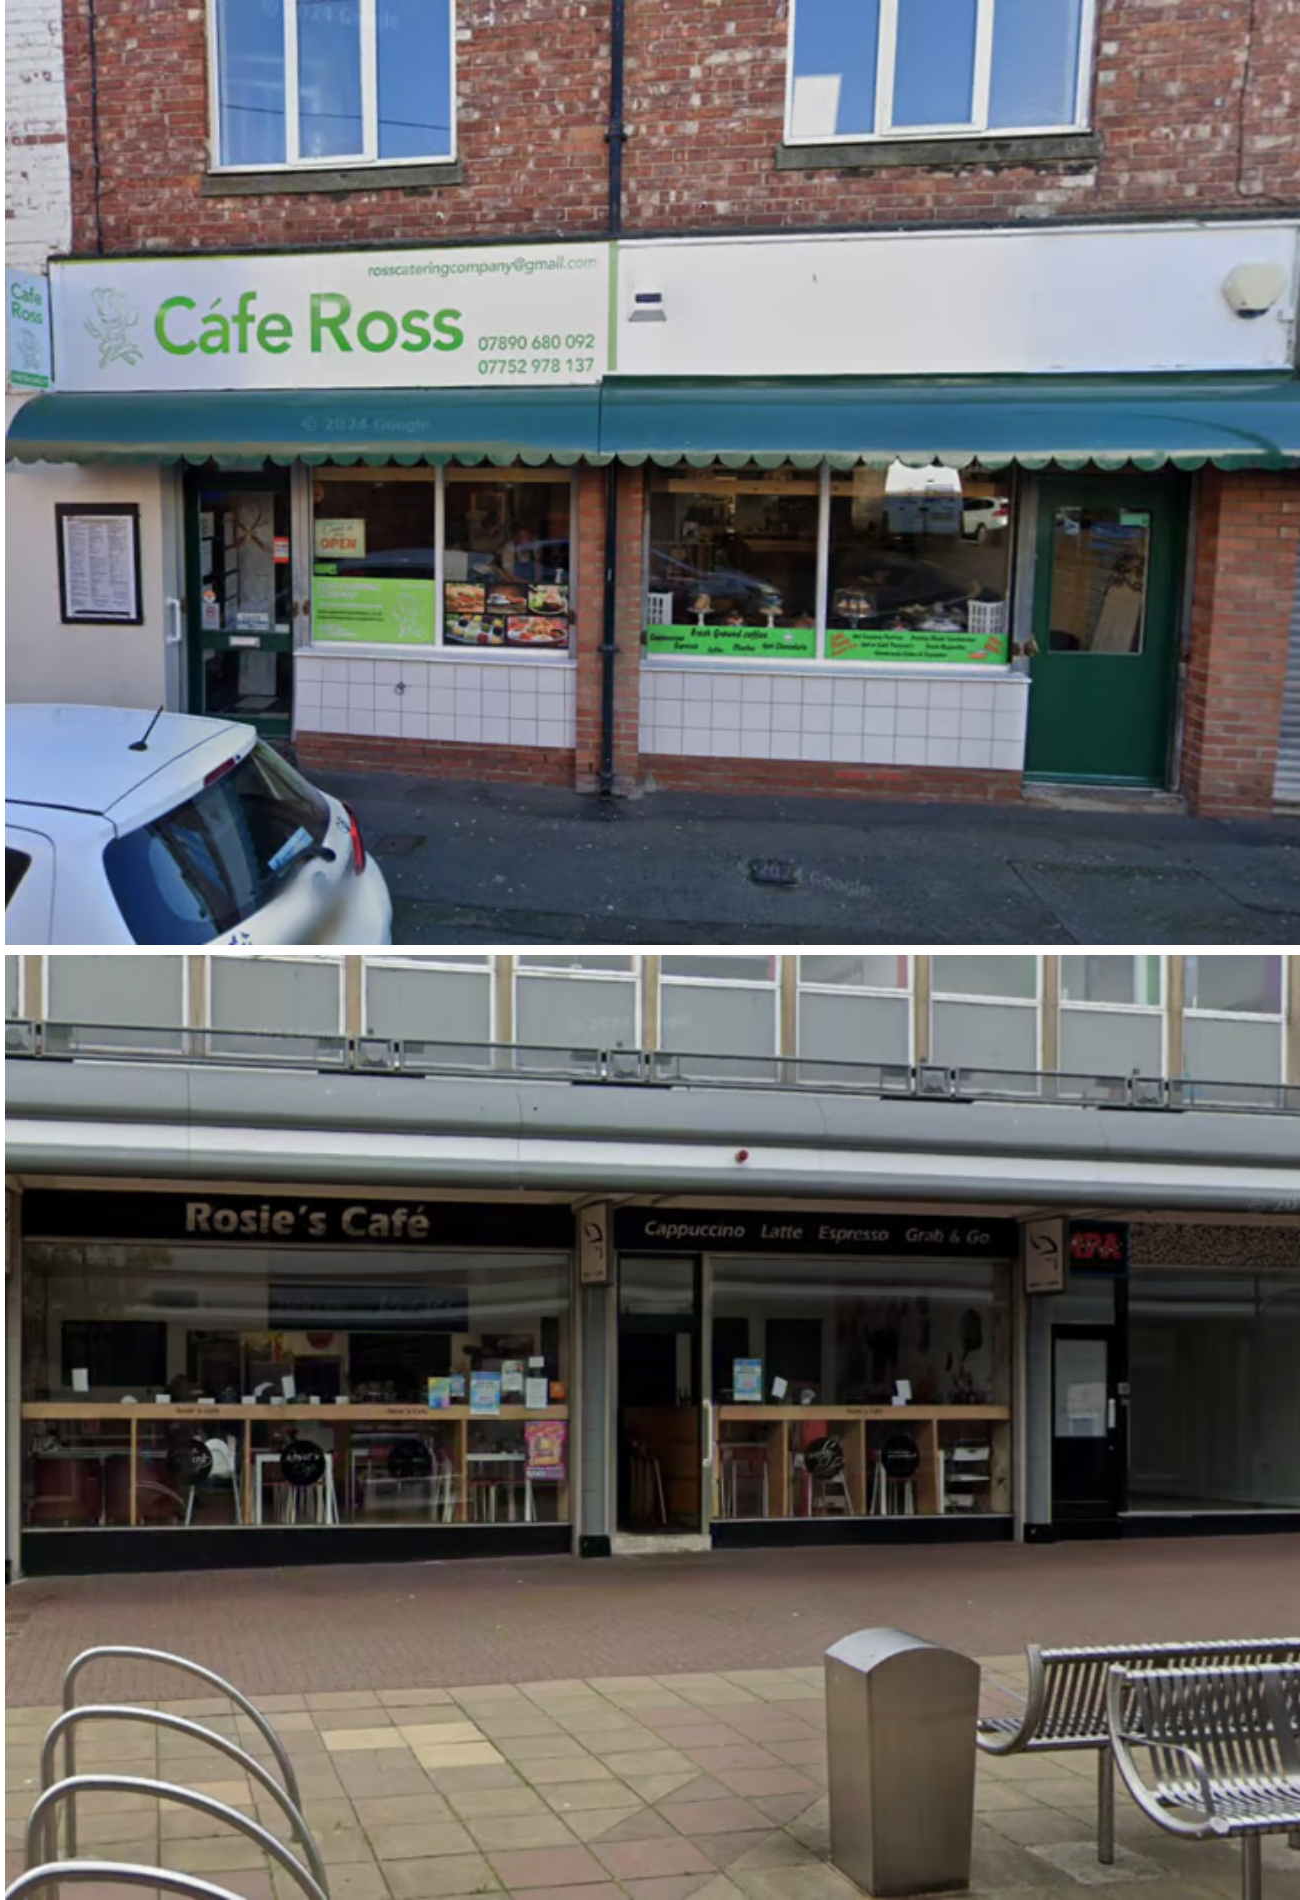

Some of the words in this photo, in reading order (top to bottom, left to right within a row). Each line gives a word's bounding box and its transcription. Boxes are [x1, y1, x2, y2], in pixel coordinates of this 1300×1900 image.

[368, 256, 597, 278] rosscateringcompany@gmail.com
[11, 301, 43, 325] Ross
[154, 290, 293, 356] Cáfe
[310, 292, 465, 353] Ross
[478, 336, 528, 351] 07890
[531, 335, 561, 350] 680
[565, 334, 595, 349] 092
[478, 358, 528, 374] 07752
[531, 358, 561, 373] 978
[566, 357, 595, 372] 137
[320, 538, 356, 550] OPEN
[185, 1202, 327, 1236] Rosie's
[341, 1205, 430, 1238] Café
[644, 1220, 746, 1239] Cappuccino
[760, 1224, 803, 1240] Latte
[818, 1225, 890, 1244] Espresso
[905, 1227, 944, 1244] Grab
[949, 1229, 960, 1243] &
[966, 1230, 990, 1245] Go
